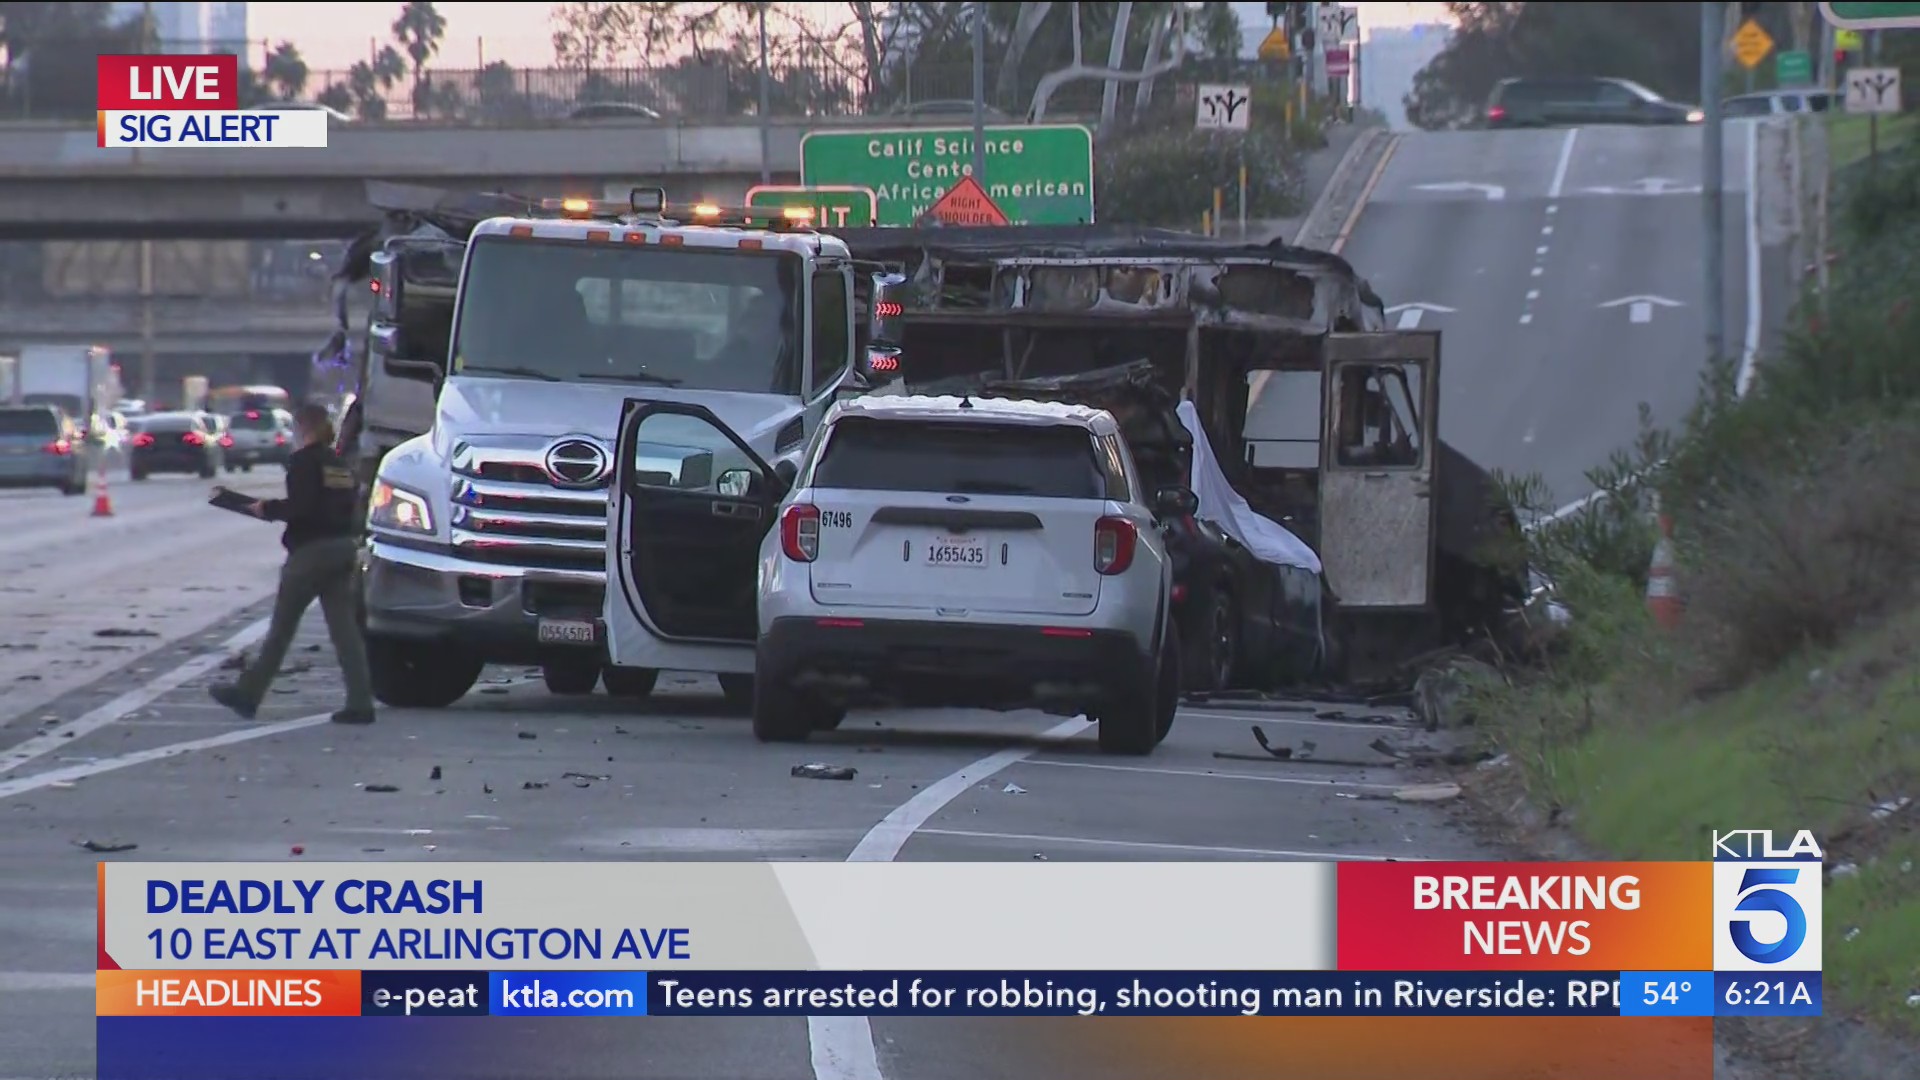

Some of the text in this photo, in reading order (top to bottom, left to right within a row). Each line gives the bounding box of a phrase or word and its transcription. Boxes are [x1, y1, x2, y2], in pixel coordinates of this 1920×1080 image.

[868, 139, 922, 157] Calif
[908, 161, 974, 178] Cente
[877, 179, 1085, 200] Africa merican
[950, 196, 981, 208] RIGHT
[822, 511, 852, 528] 67496
[928, 545, 983, 563] 1655435
